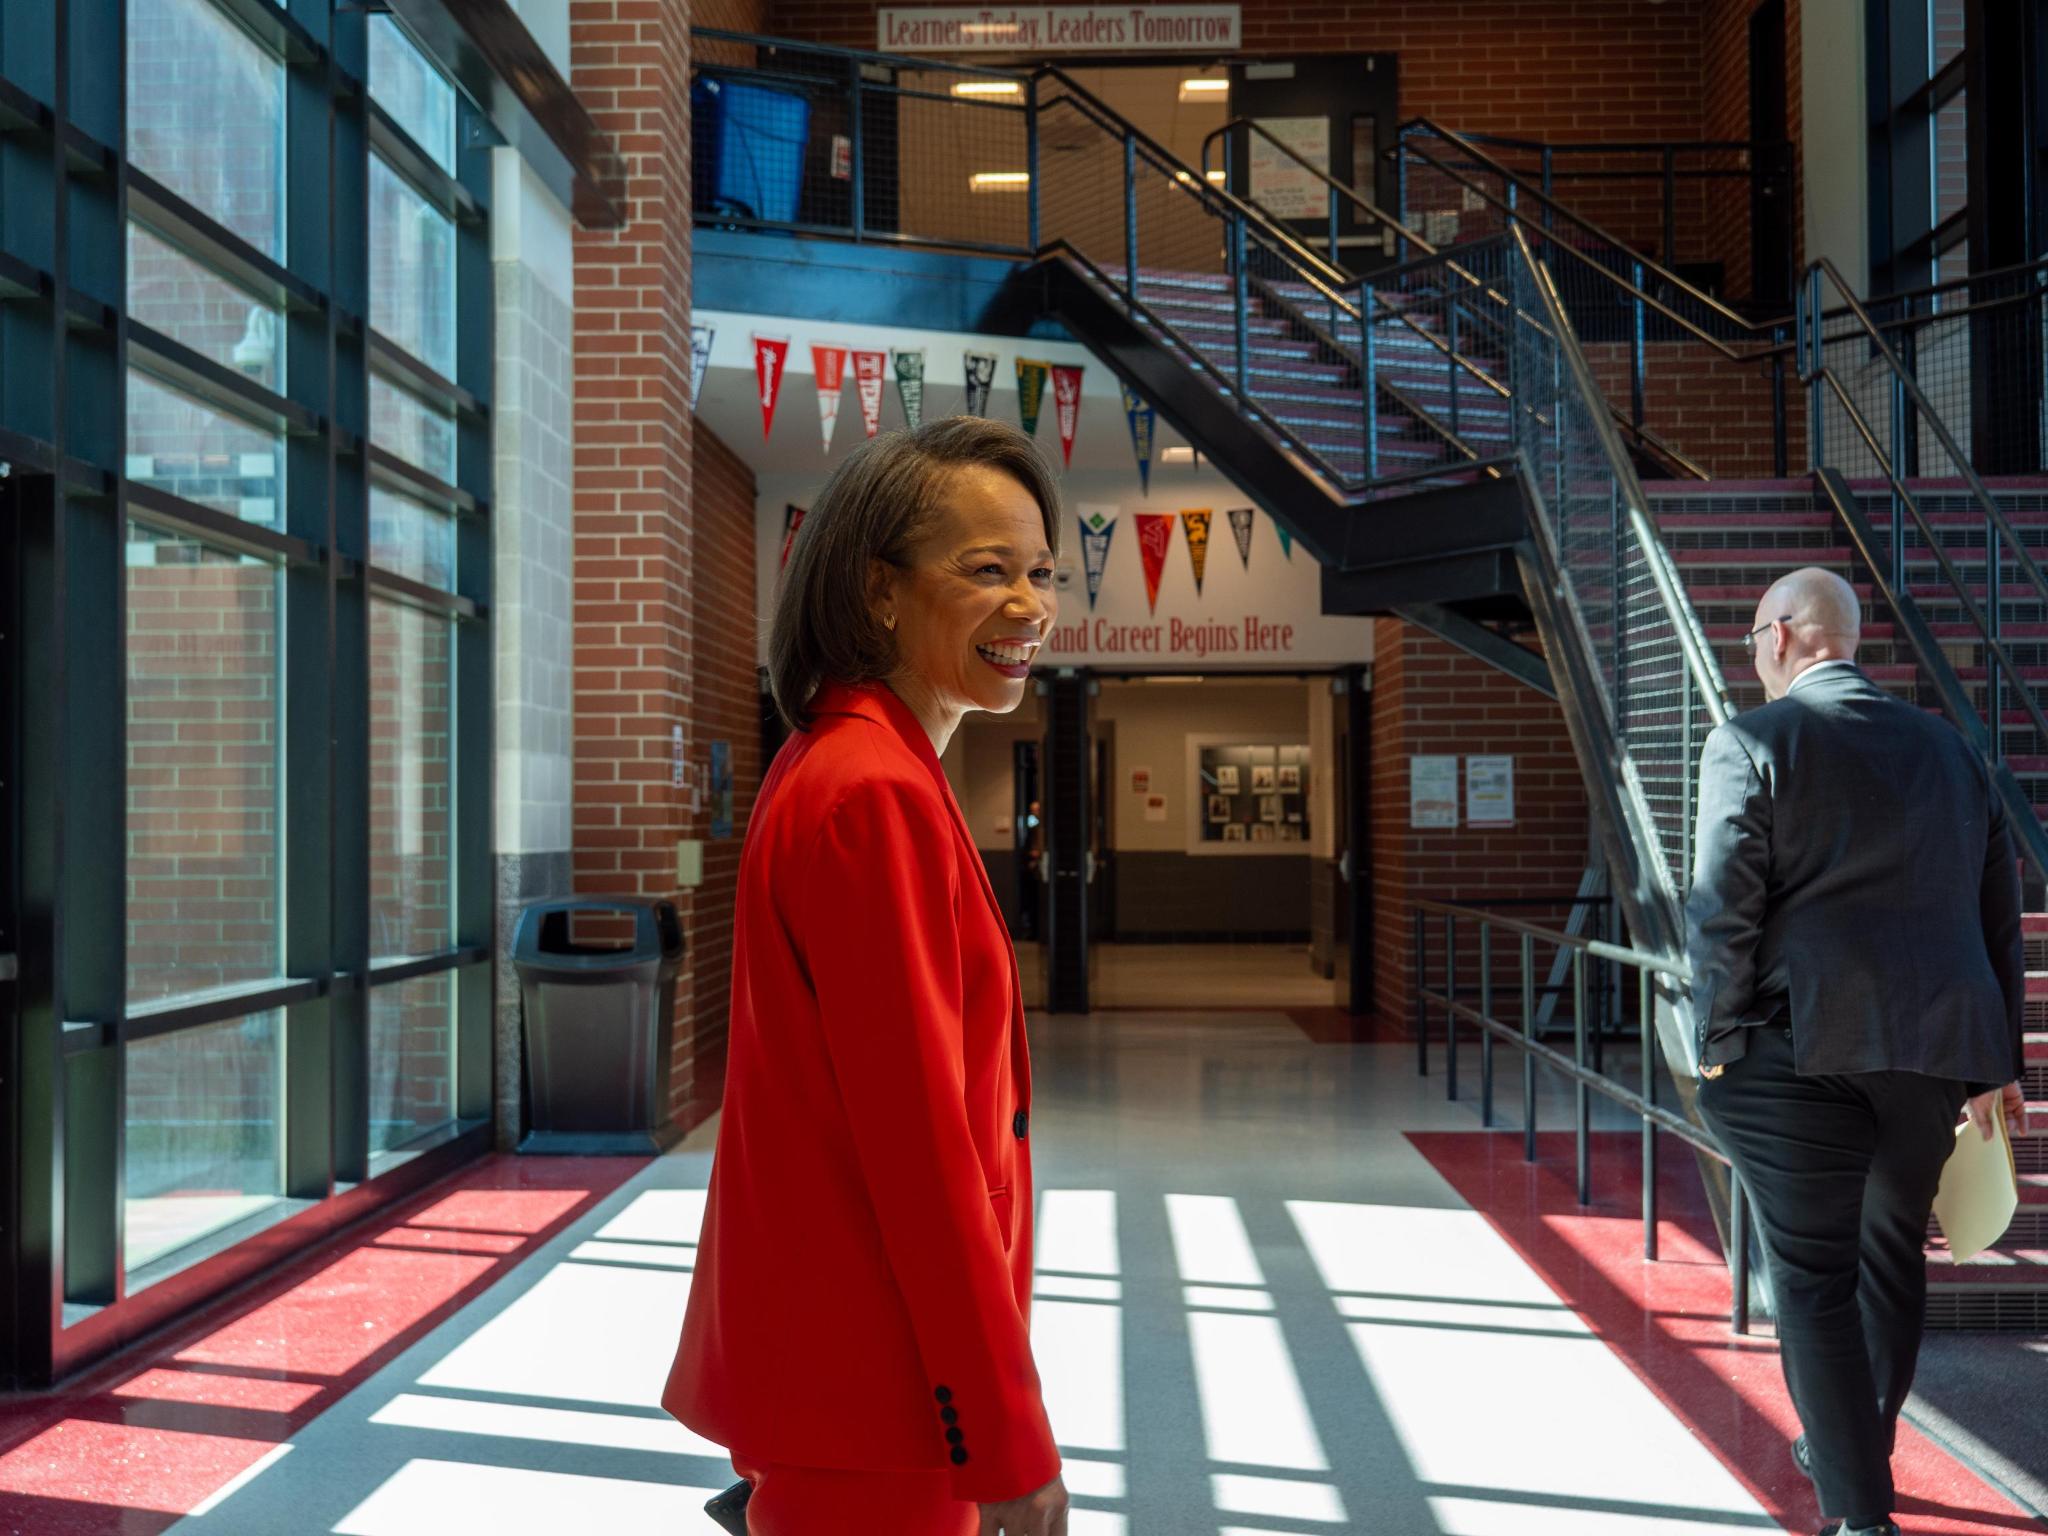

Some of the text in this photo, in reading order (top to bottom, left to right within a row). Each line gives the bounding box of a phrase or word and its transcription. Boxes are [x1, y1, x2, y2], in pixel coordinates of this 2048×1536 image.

[886, 12, 975, 46] Learners
[1047, 10, 1126, 45] Leaders
[1129, 9, 1233, 43] Tomorrow
[859, 378, 882, 433] TEMPLE
[1051, 616, 1294, 658] and Career Begins Here
